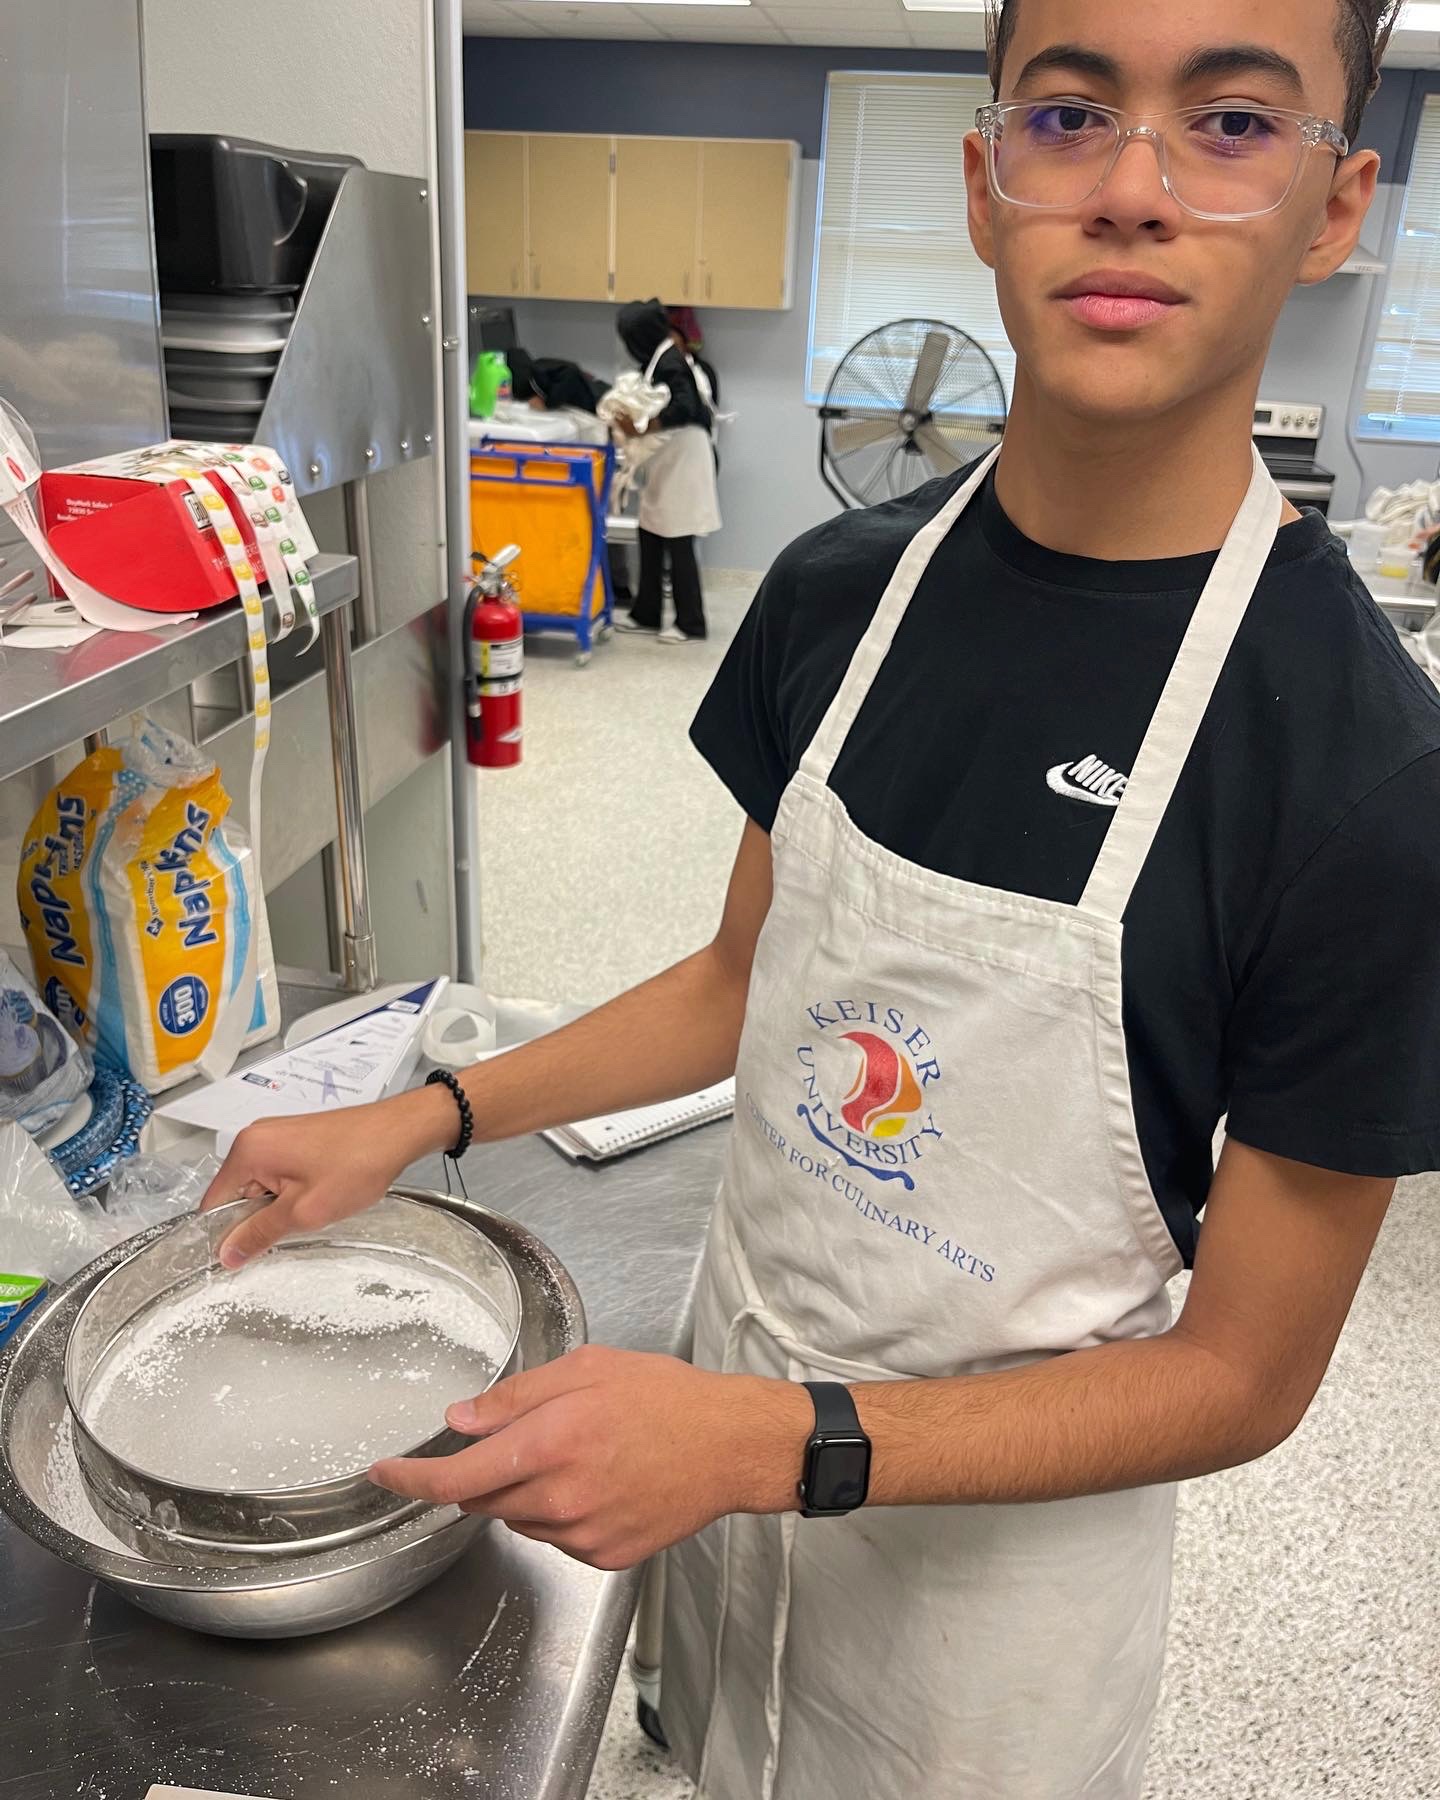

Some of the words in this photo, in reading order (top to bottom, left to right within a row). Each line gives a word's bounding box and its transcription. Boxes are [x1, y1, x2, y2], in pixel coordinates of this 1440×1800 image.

[174, 985, 196, 1027] 300
[806, 999, 941, 1087] KEISER
[797, 1046, 943, 1165] UNIVERSITY
[789, 1147, 828, 1182] FOR
[832, 1174, 936, 1245] CULINARY
[937, 1239, 995, 1283] ARTS
